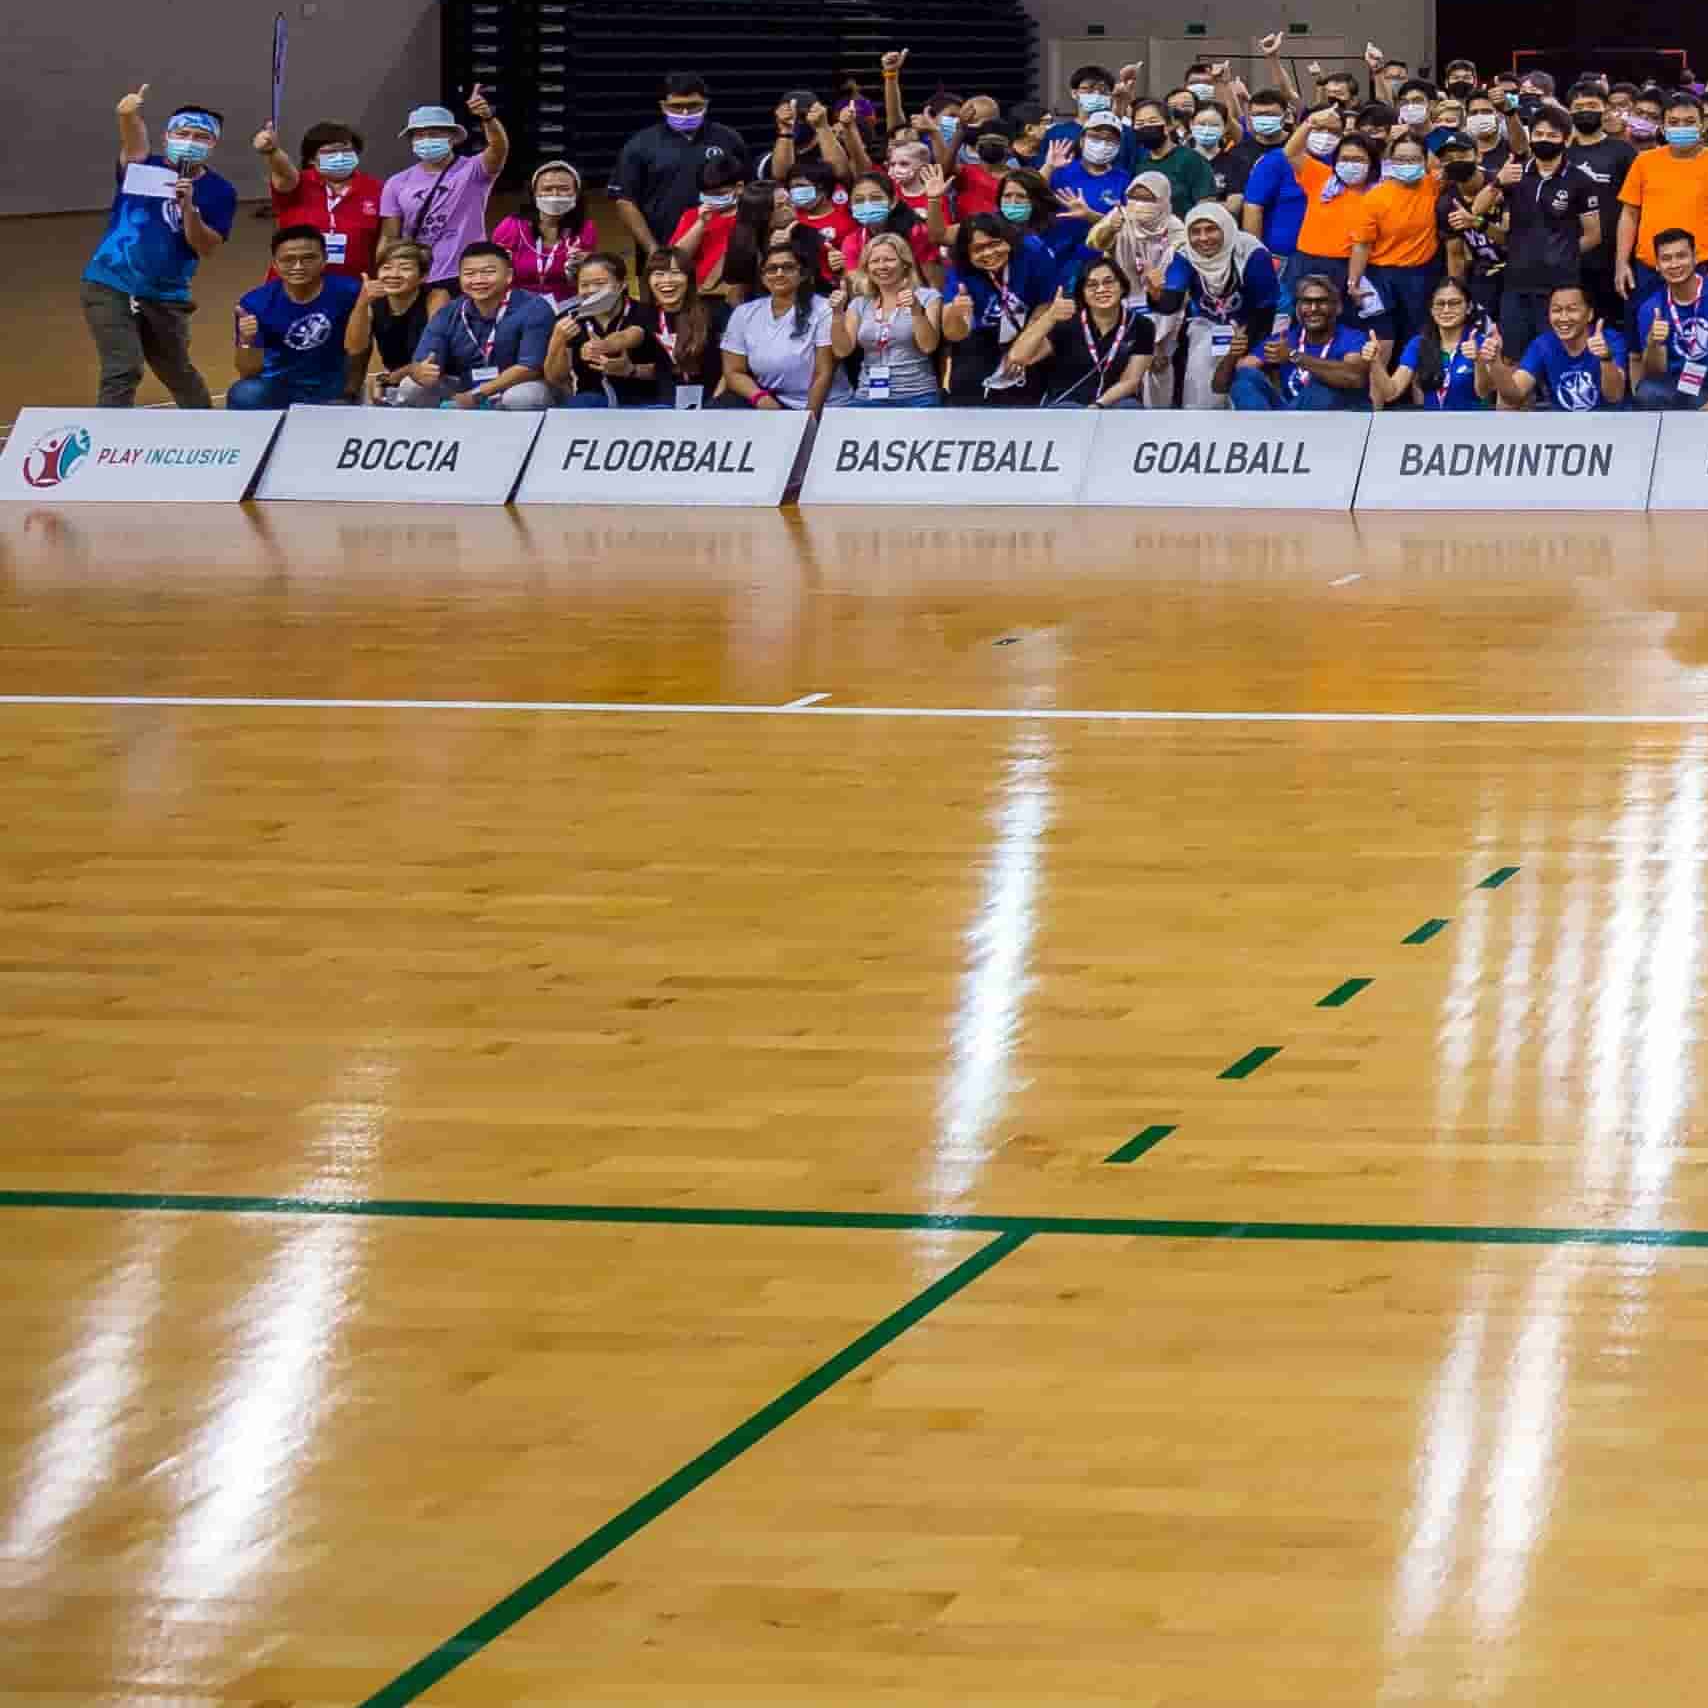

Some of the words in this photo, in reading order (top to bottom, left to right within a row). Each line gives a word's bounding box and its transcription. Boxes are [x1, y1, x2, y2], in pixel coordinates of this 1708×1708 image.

[97, 449, 142, 466] PLAY
[145, 448, 241, 466] INCLUSIVE
[336, 438, 458, 472] BOCCIA
[561, 439, 756, 474] FLOORBALL
[835, 440, 1061, 473] BASKETBALL
[1133, 441, 1312, 475] GOALBALL
[1399, 443, 1613, 477] BADMINTON
